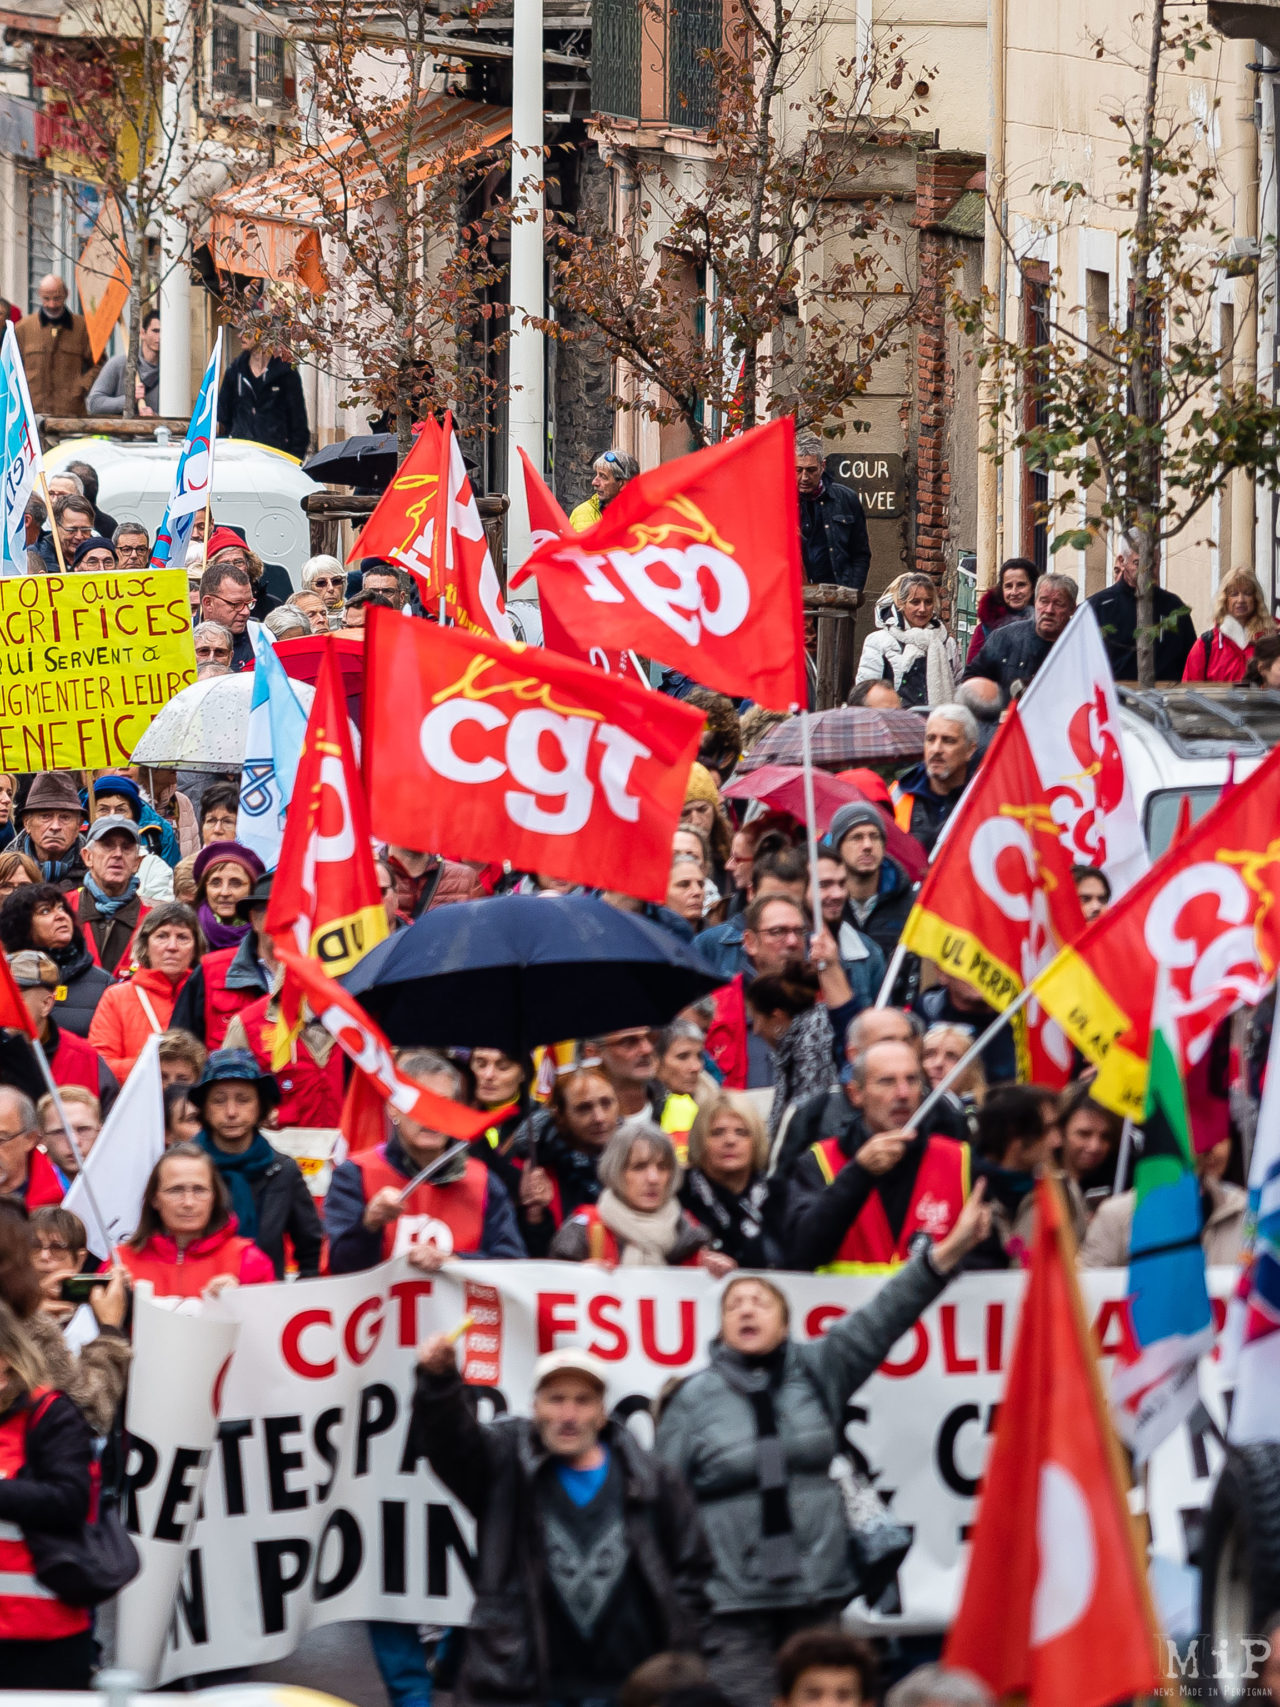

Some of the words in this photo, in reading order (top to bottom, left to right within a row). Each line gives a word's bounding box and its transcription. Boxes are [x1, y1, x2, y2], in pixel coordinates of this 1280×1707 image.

[838, 460, 889, 479] COUR
[81, 576, 157, 604] aux
[43, 645, 134, 673] SERVENT
[419, 697, 652, 837] cgt
[279, 1279, 433, 1380] CGT
